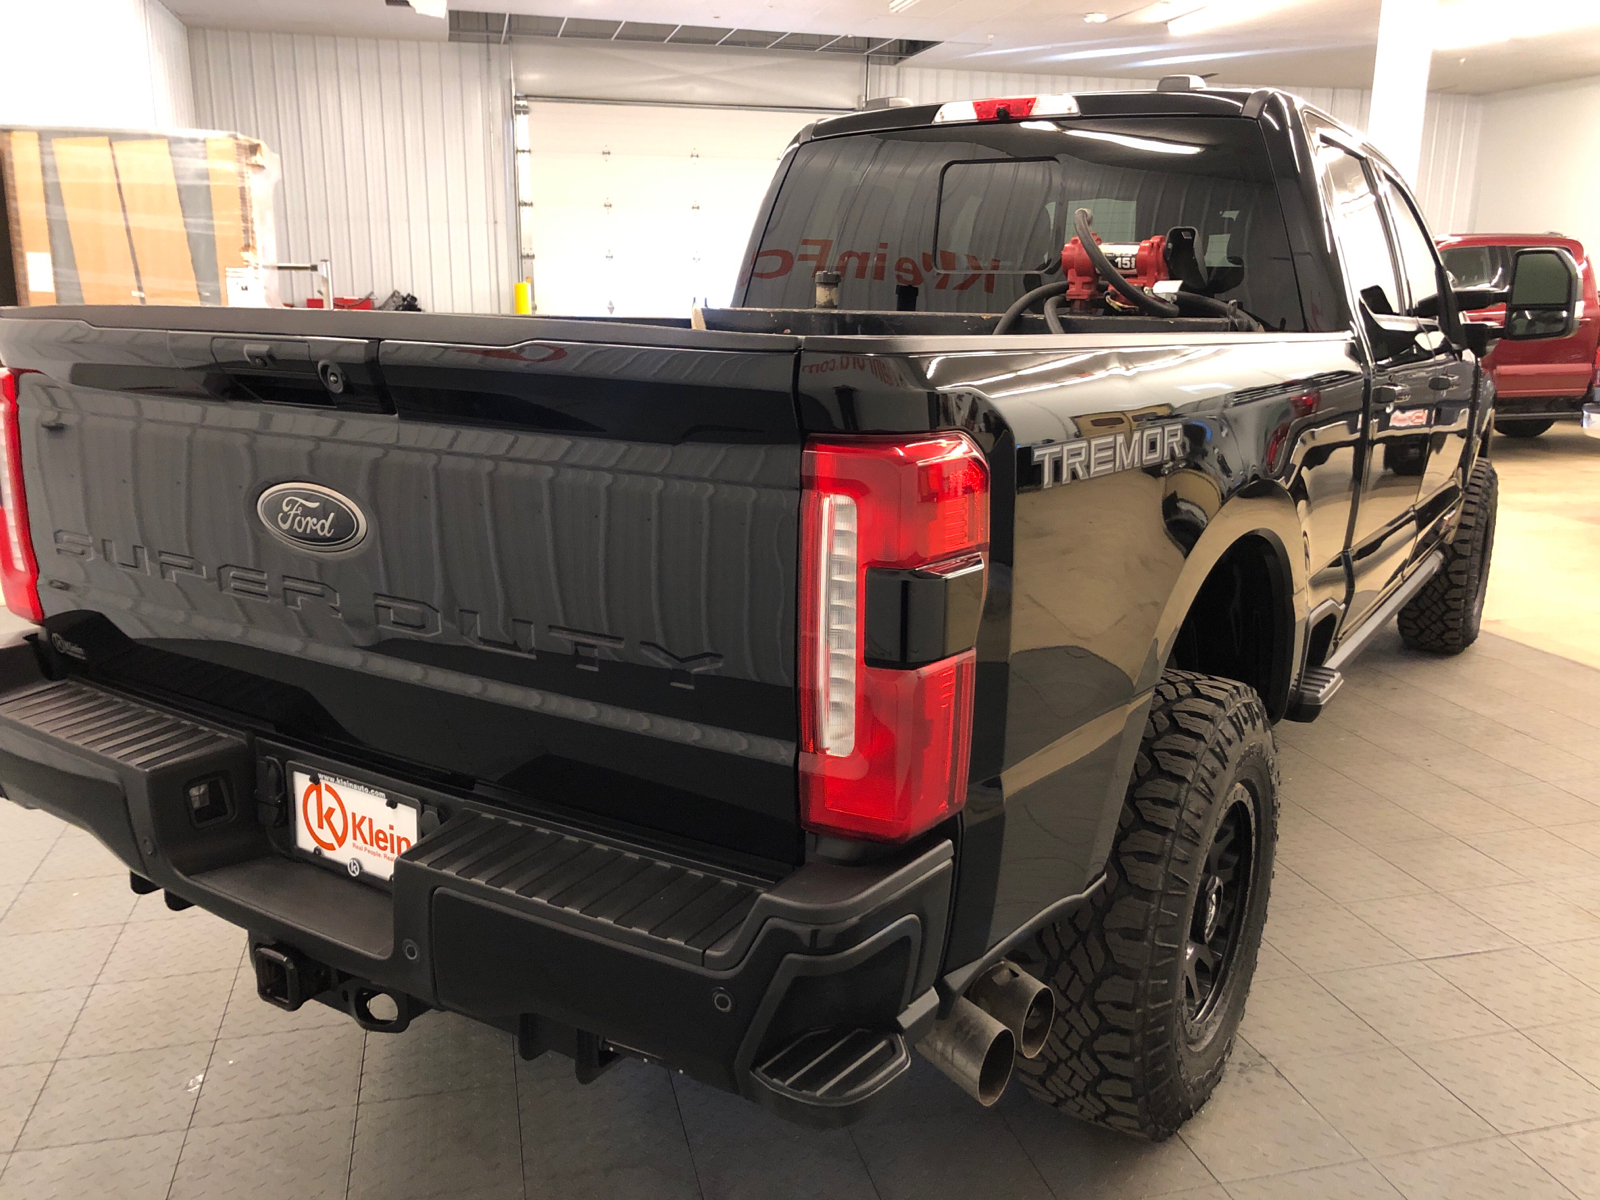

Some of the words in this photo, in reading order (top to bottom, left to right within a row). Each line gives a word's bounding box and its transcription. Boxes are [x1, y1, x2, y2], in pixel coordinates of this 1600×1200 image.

[1032, 422, 1185, 489] TREMOR
[278, 496, 335, 537] Ford
[54, 529, 342, 618] SUPER
[373, 592, 724, 690] DUTY
[317, 772, 387, 799] www.kleinauto.com
[351, 811, 412, 857] Klein
